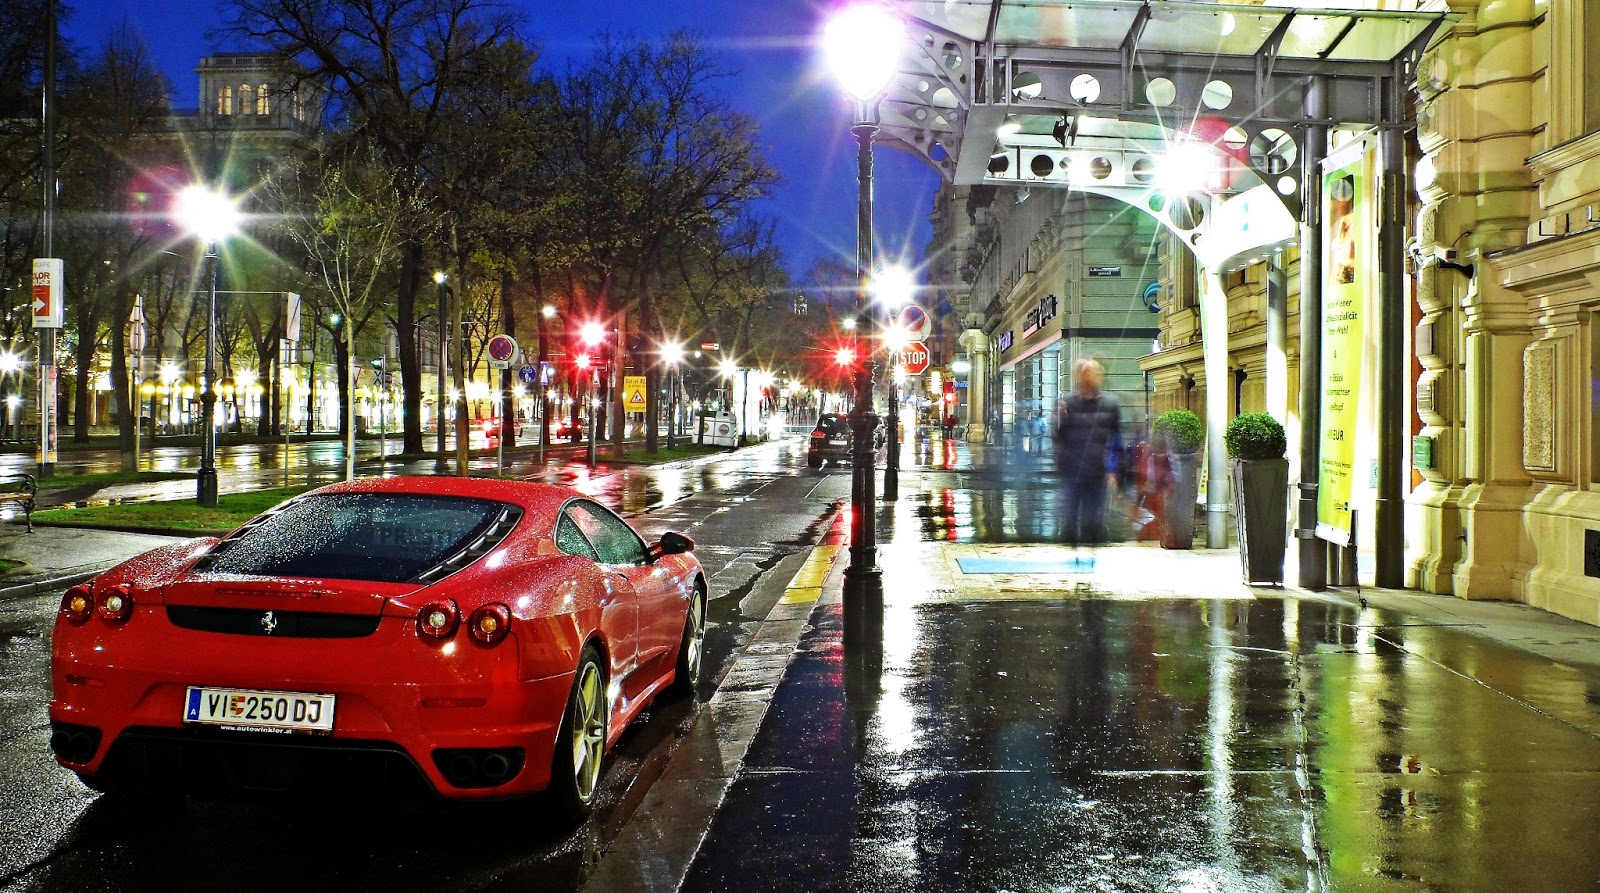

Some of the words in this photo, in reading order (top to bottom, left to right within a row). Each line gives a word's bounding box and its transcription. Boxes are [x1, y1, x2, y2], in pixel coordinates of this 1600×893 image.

[900, 351, 926, 365] STOP
[1333, 429, 1344, 442] EUR
[190, 708, 197, 716] A
[208, 693, 228, 718] VI
[245, 696, 288, 721] 250
[293, 699, 322, 723] DJ
[221, 725, 292, 734] www.autowinkler.at
